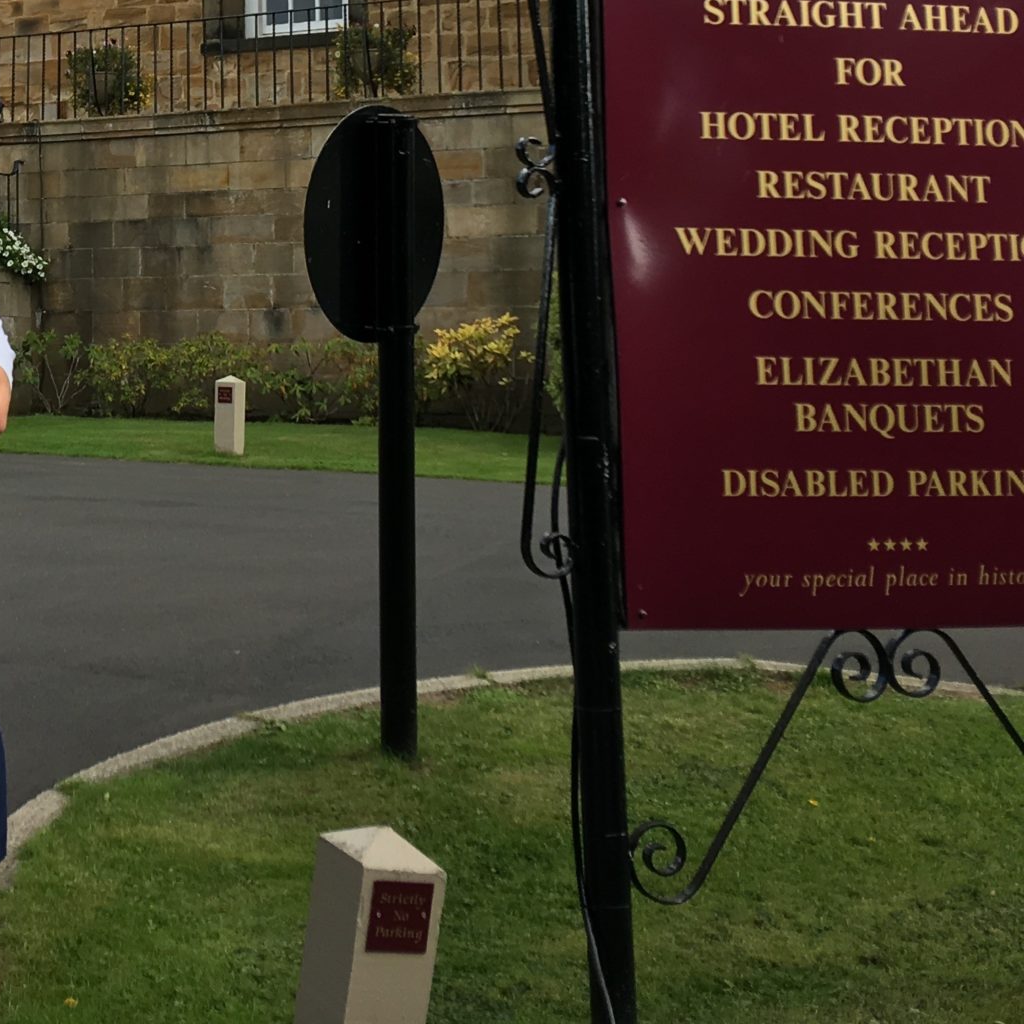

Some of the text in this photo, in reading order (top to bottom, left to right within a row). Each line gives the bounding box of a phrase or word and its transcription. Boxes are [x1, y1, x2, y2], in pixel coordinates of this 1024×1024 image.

[899, 3, 1019, 35] AHEAD
[835, 57, 906, 87] FOR
[699, 111, 825, 142] HOTEL
[756, 170, 990, 204] RESTAURANT
[674, 226, 1024, 262] WEDDING RECEPTI
[748, 289, 1014, 323] CONFERENCES
[755, 356, 1012, 388] ELIZABETHAN
[794, 402, 985, 439] BANQUETS
[721, 469, 1024, 498] DISABLED PARKIN
[739, 572, 793, 597] your
[801, 565, 875, 596] special
[884, 565, 939, 596] place
[949, 567, 968, 586] in
[375, 926, 424, 944] Parking
